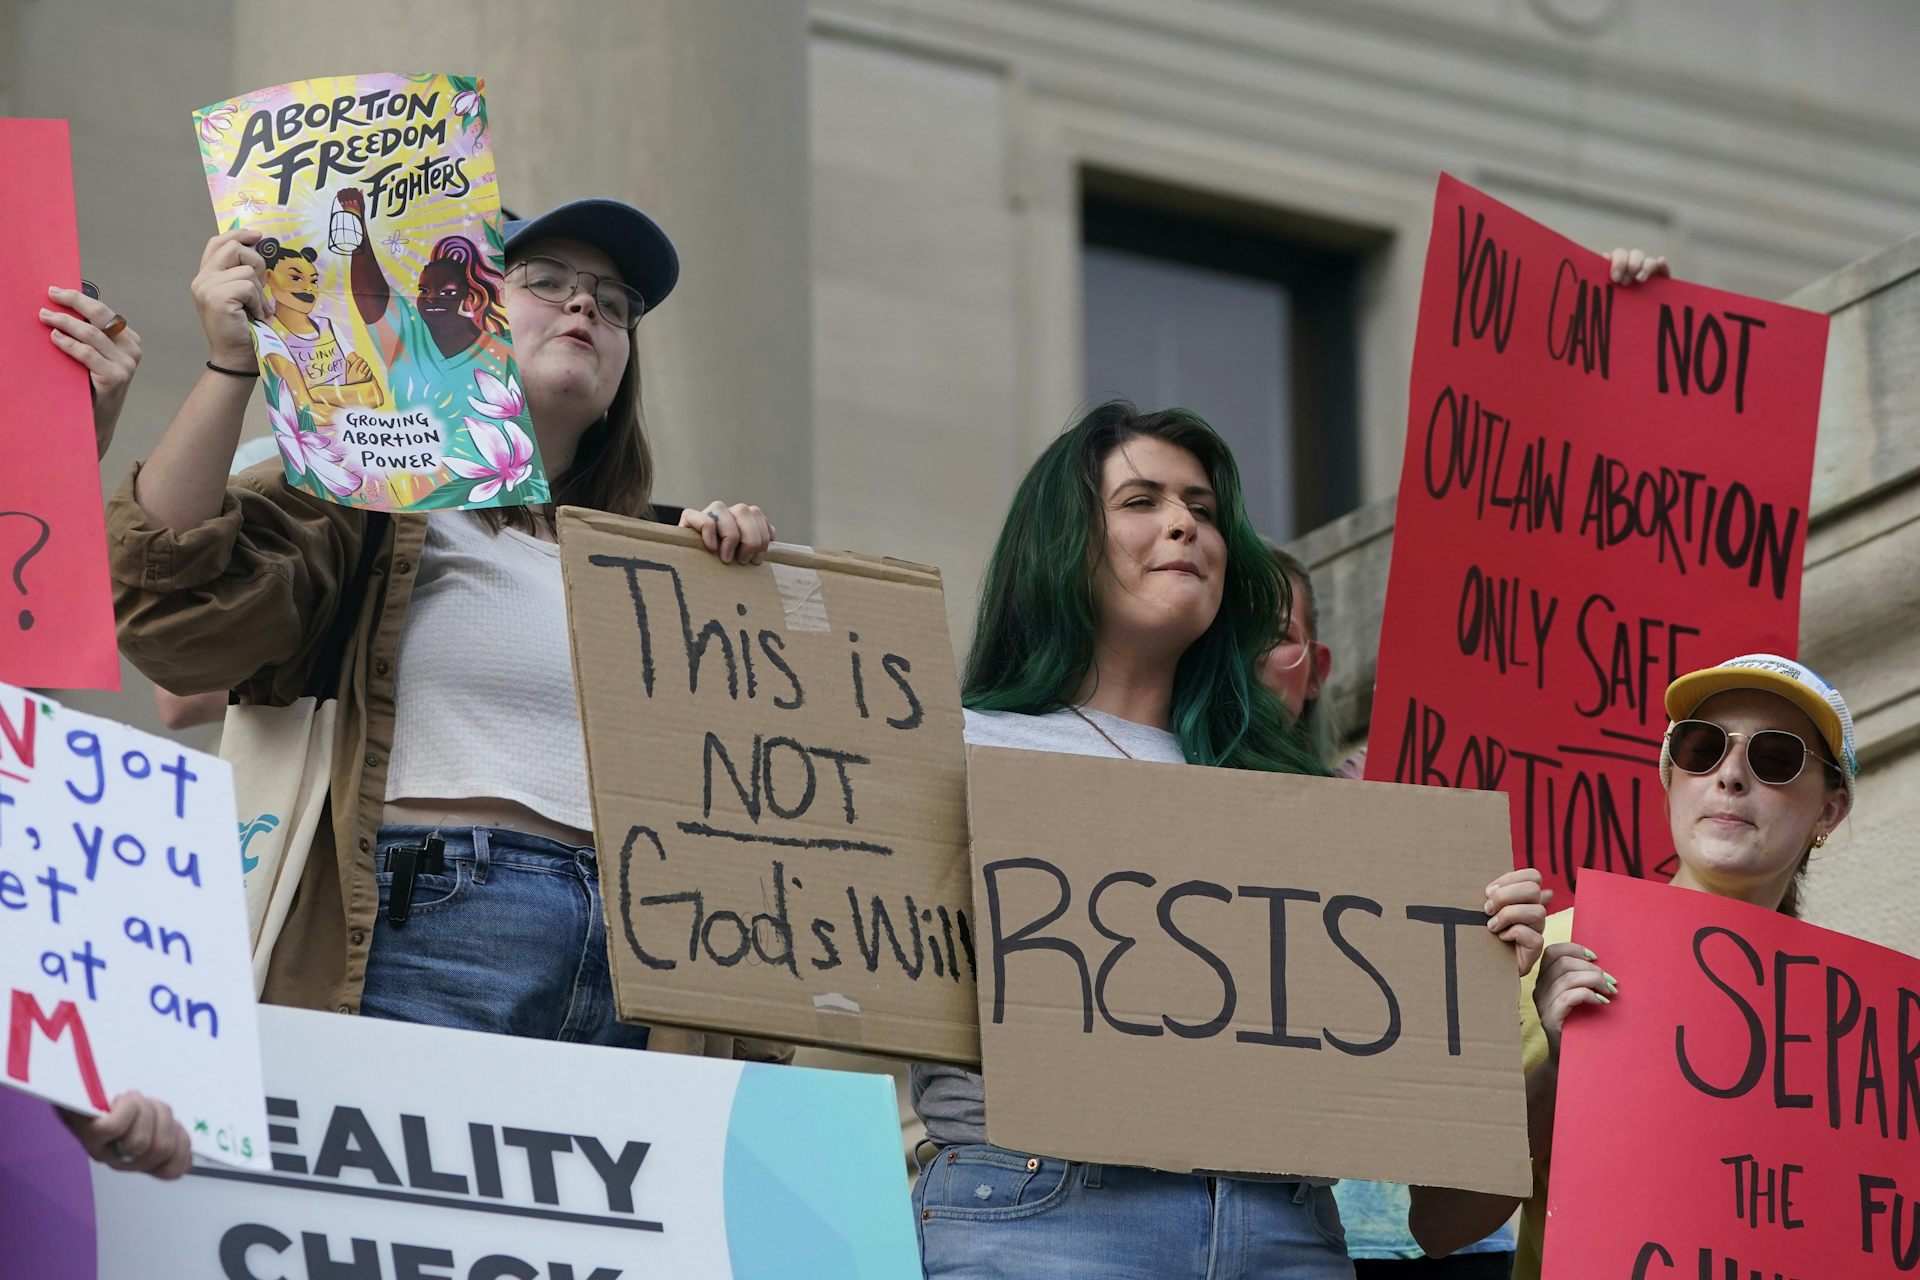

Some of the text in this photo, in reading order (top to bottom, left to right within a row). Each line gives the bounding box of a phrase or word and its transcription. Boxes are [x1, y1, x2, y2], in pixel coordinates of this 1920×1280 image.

[227, 89, 440, 178] ABORTION
[257, 119, 446, 205] FREEDOM
[1451, 204, 1767, 415] YOU CAN NOT
[305, 358, 343, 380] ESCORT
[342, 429, 441, 448] ABORTION
[346, 412, 430, 429] GROWING
[361, 450, 437, 469] POWER
[1424, 385, 1800, 601] OUTLAW ABORTION
[588, 553, 925, 730] This is
[1457, 564, 1559, 690] ONLY
[65, 729, 198, 819] got
[702, 731, 871, 825] NOT
[1394, 696, 1679, 895] ABTION
[73, 822, 203, 888] you
[618, 824, 978, 984] God's Will
[123, 916, 193, 964] an
[982, 857, 1492, 1057] RESIST
[40, 941, 219, 1039] at an
[1675, 926, 1920, 1141] SEPAR
[7, 988, 112, 1115] M
[1720, 1153, 1805, 1230] THE
[1858, 1172, 1920, 1272] FU
